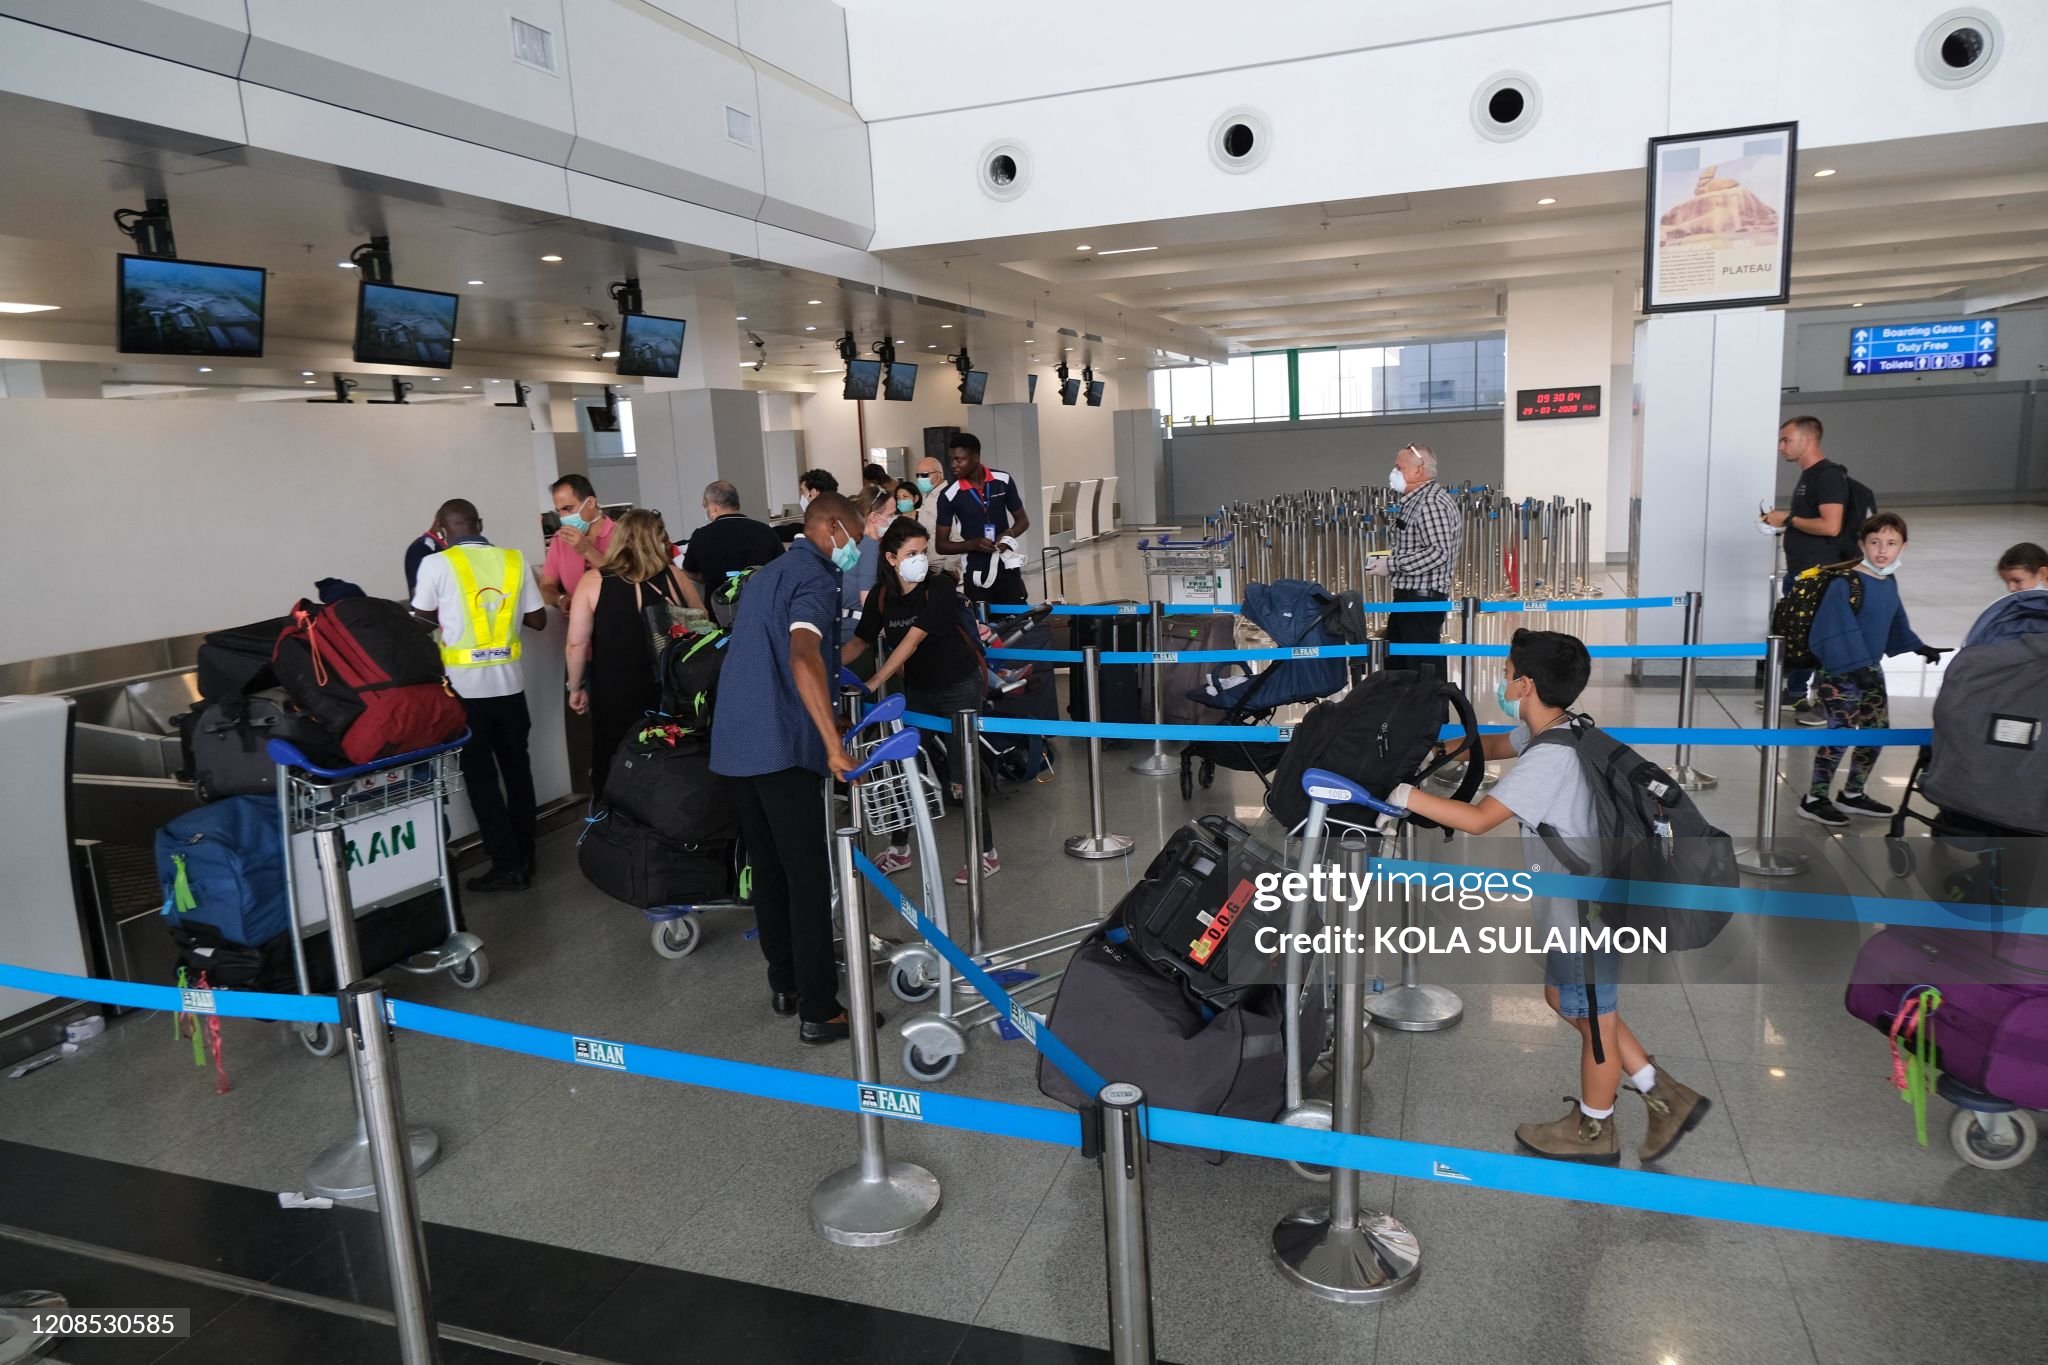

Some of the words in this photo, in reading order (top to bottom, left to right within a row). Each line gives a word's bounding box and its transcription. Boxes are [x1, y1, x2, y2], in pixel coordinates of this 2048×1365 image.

[1722, 263, 1772, 275] PLATEAU
[1882, 326, 1931, 338] Boarding
[1932, 324, 1966, 335] Gates
[1896, 343, 1922, 353] Duty
[1923, 341, 1949, 351] Free
[1880, 360, 1914, 370] Toilets
[345, 820, 416, 872] AAN
[589, 1042, 625, 1065] FAAN
[878, 1090, 921, 1115] FAAN
